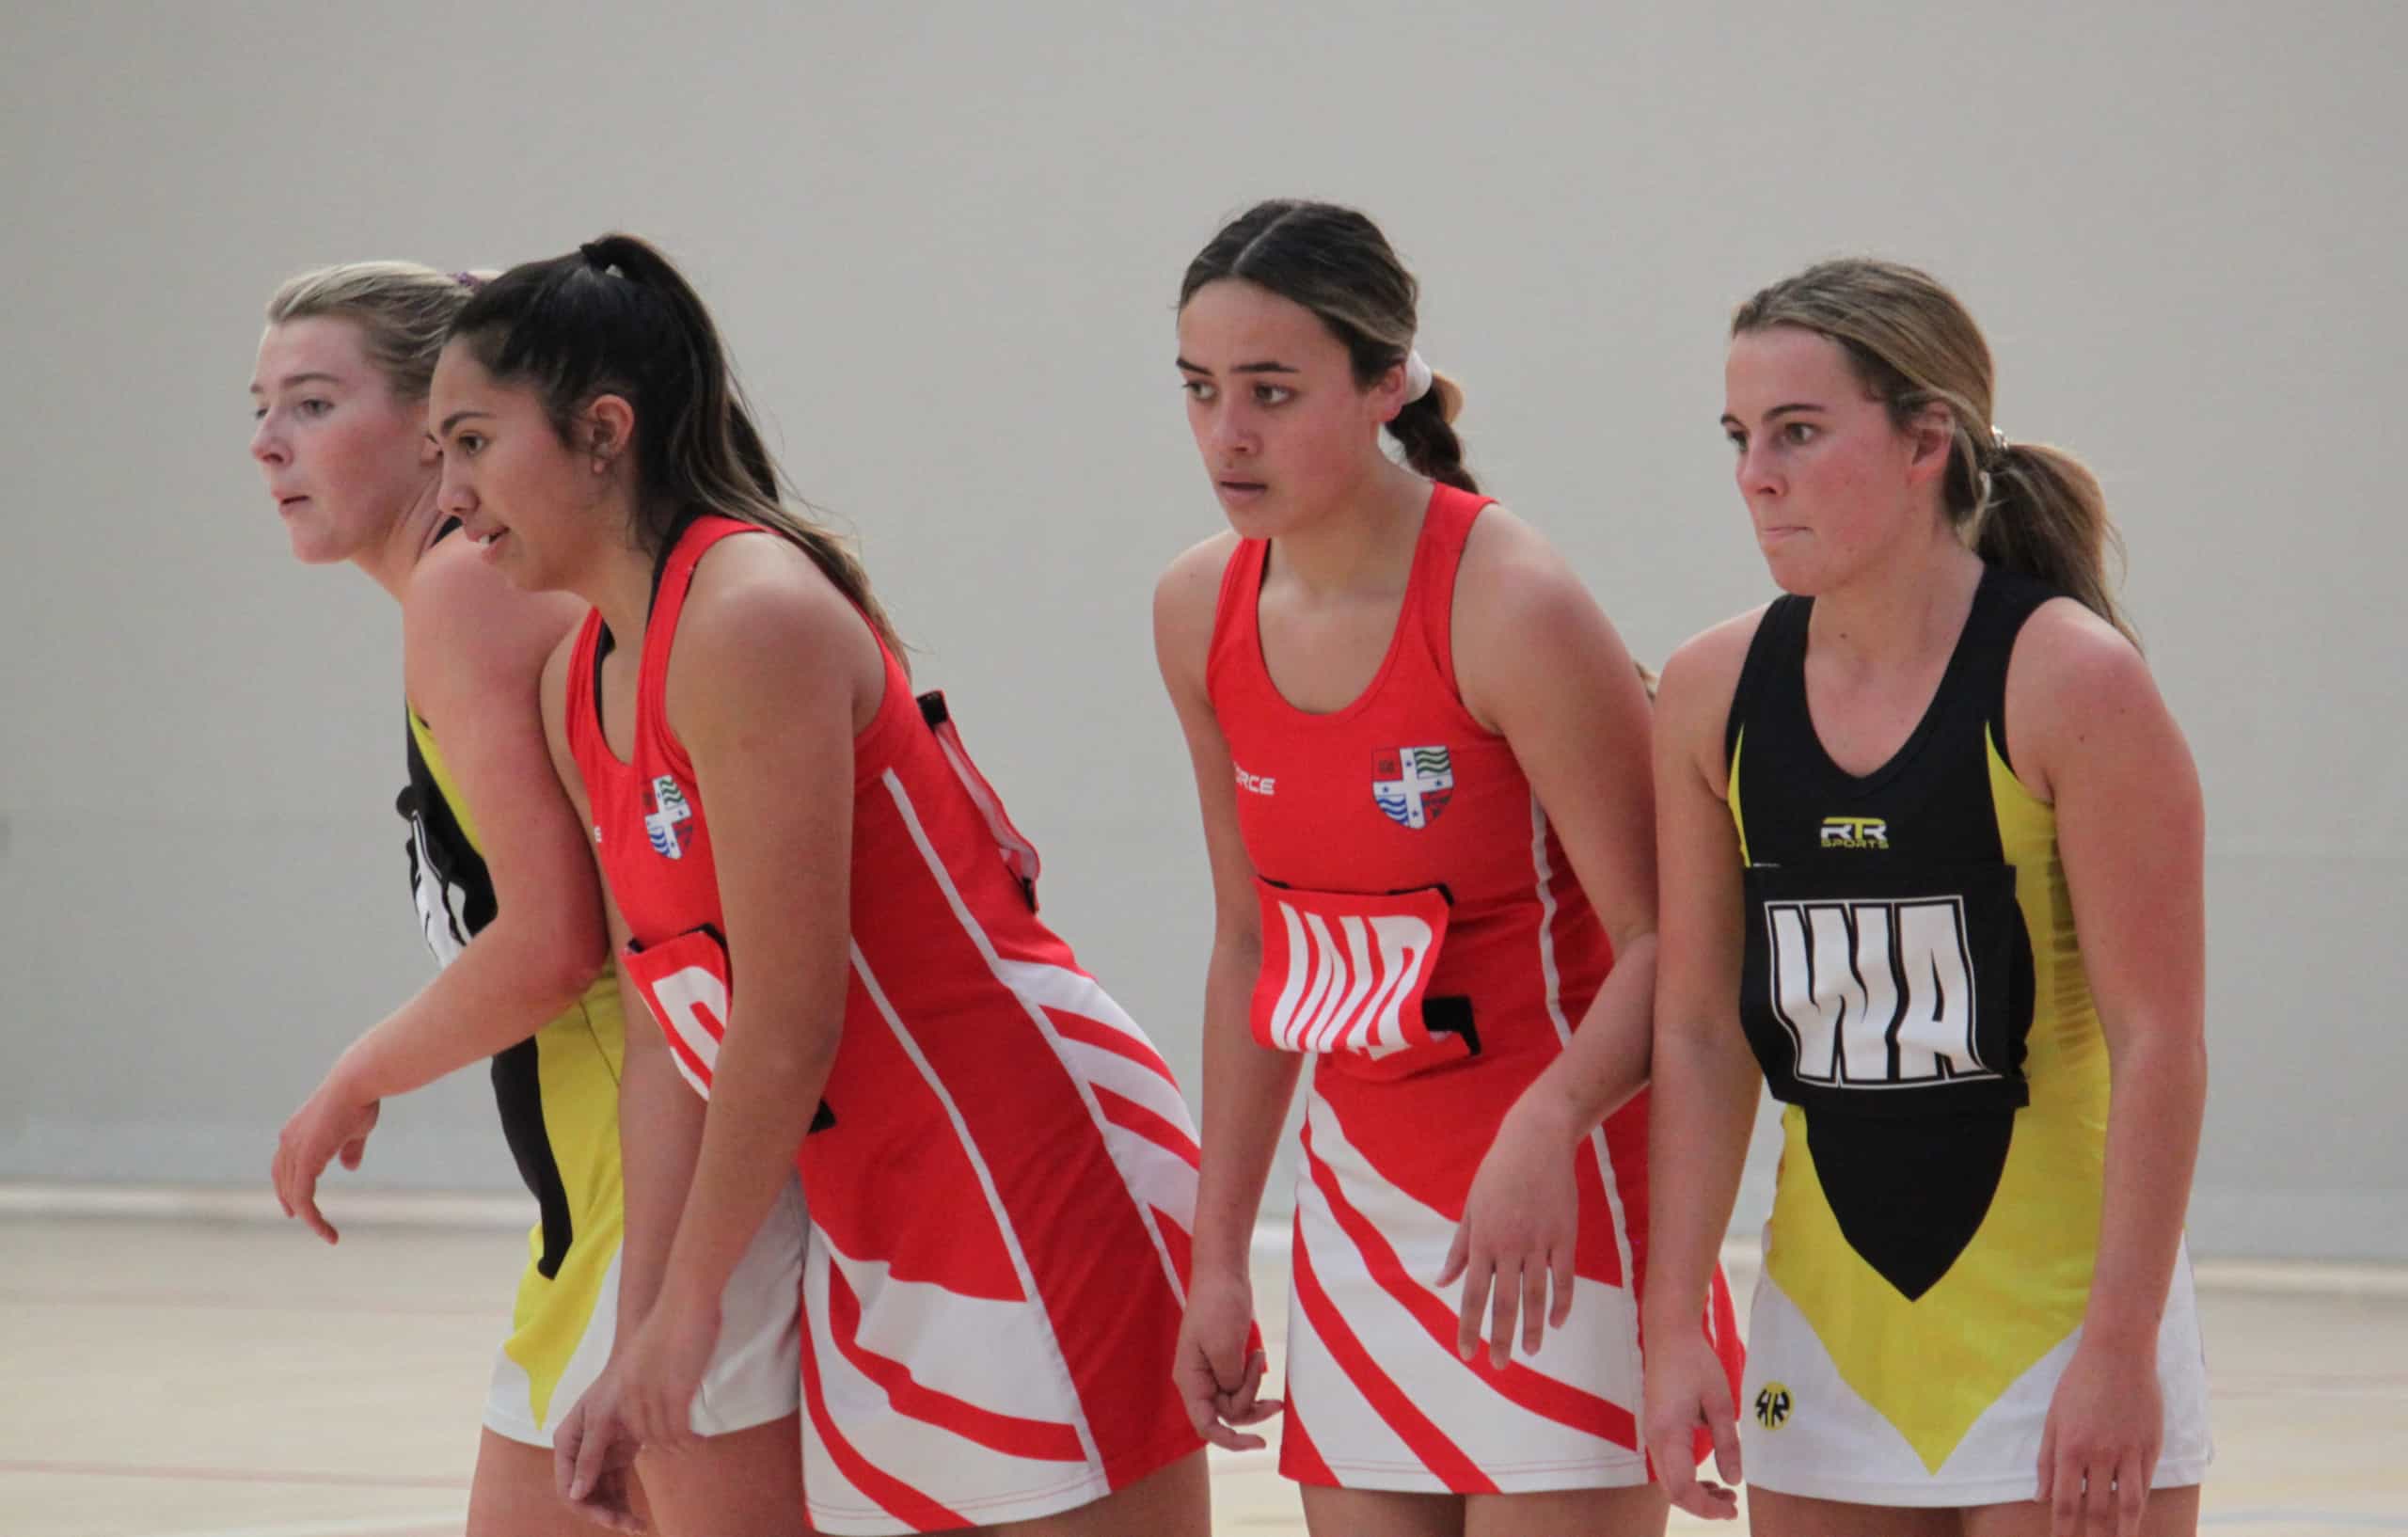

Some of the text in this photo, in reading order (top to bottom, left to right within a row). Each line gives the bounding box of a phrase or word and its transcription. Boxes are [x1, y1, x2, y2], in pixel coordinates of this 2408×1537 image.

[1821, 816, 1887, 840] RTR
[1821, 838, 1890, 849] SPORTS
[1270, 900, 1433, 1061] WD
[1763, 895, 2002, 1089] WA
